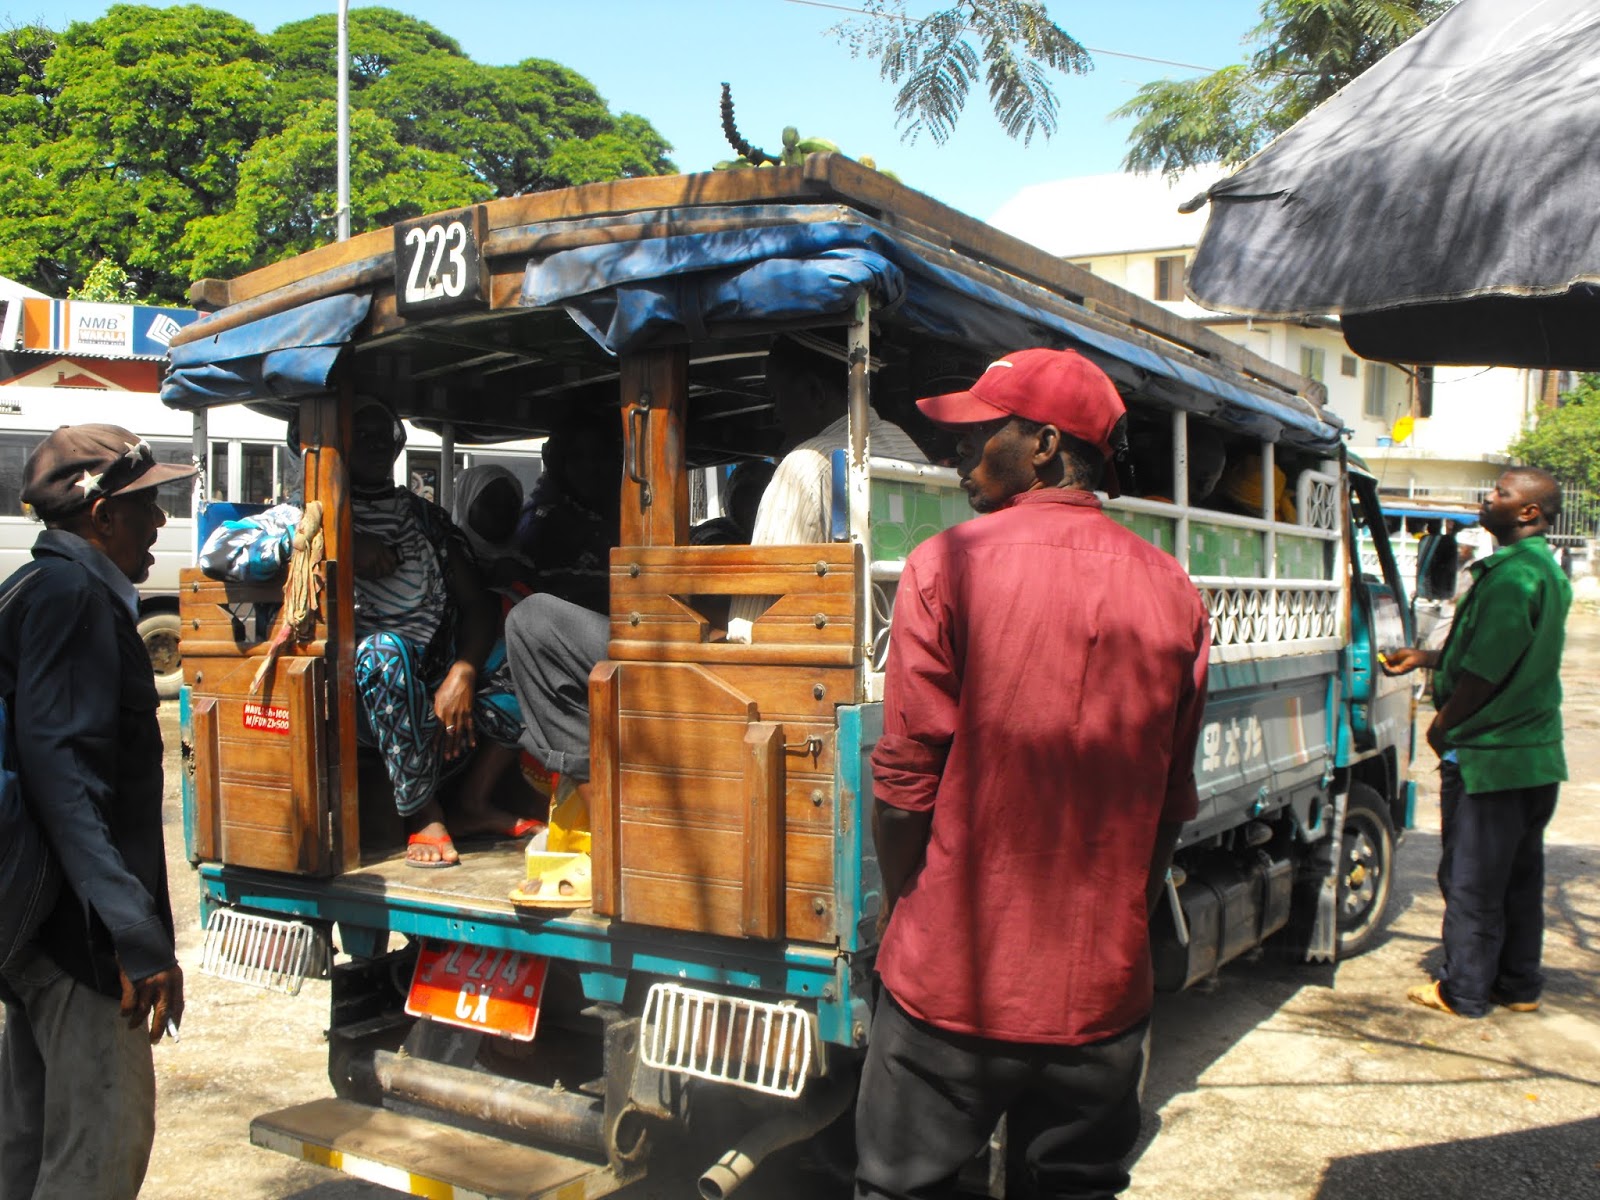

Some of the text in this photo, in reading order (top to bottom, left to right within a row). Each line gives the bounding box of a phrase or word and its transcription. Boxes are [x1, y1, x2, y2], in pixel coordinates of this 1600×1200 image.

[405, 221, 467, 303] 223
[79, 316, 118, 330] NMB
[79, 329, 125, 342] WAKALA
[455, 981, 493, 1024] CX
